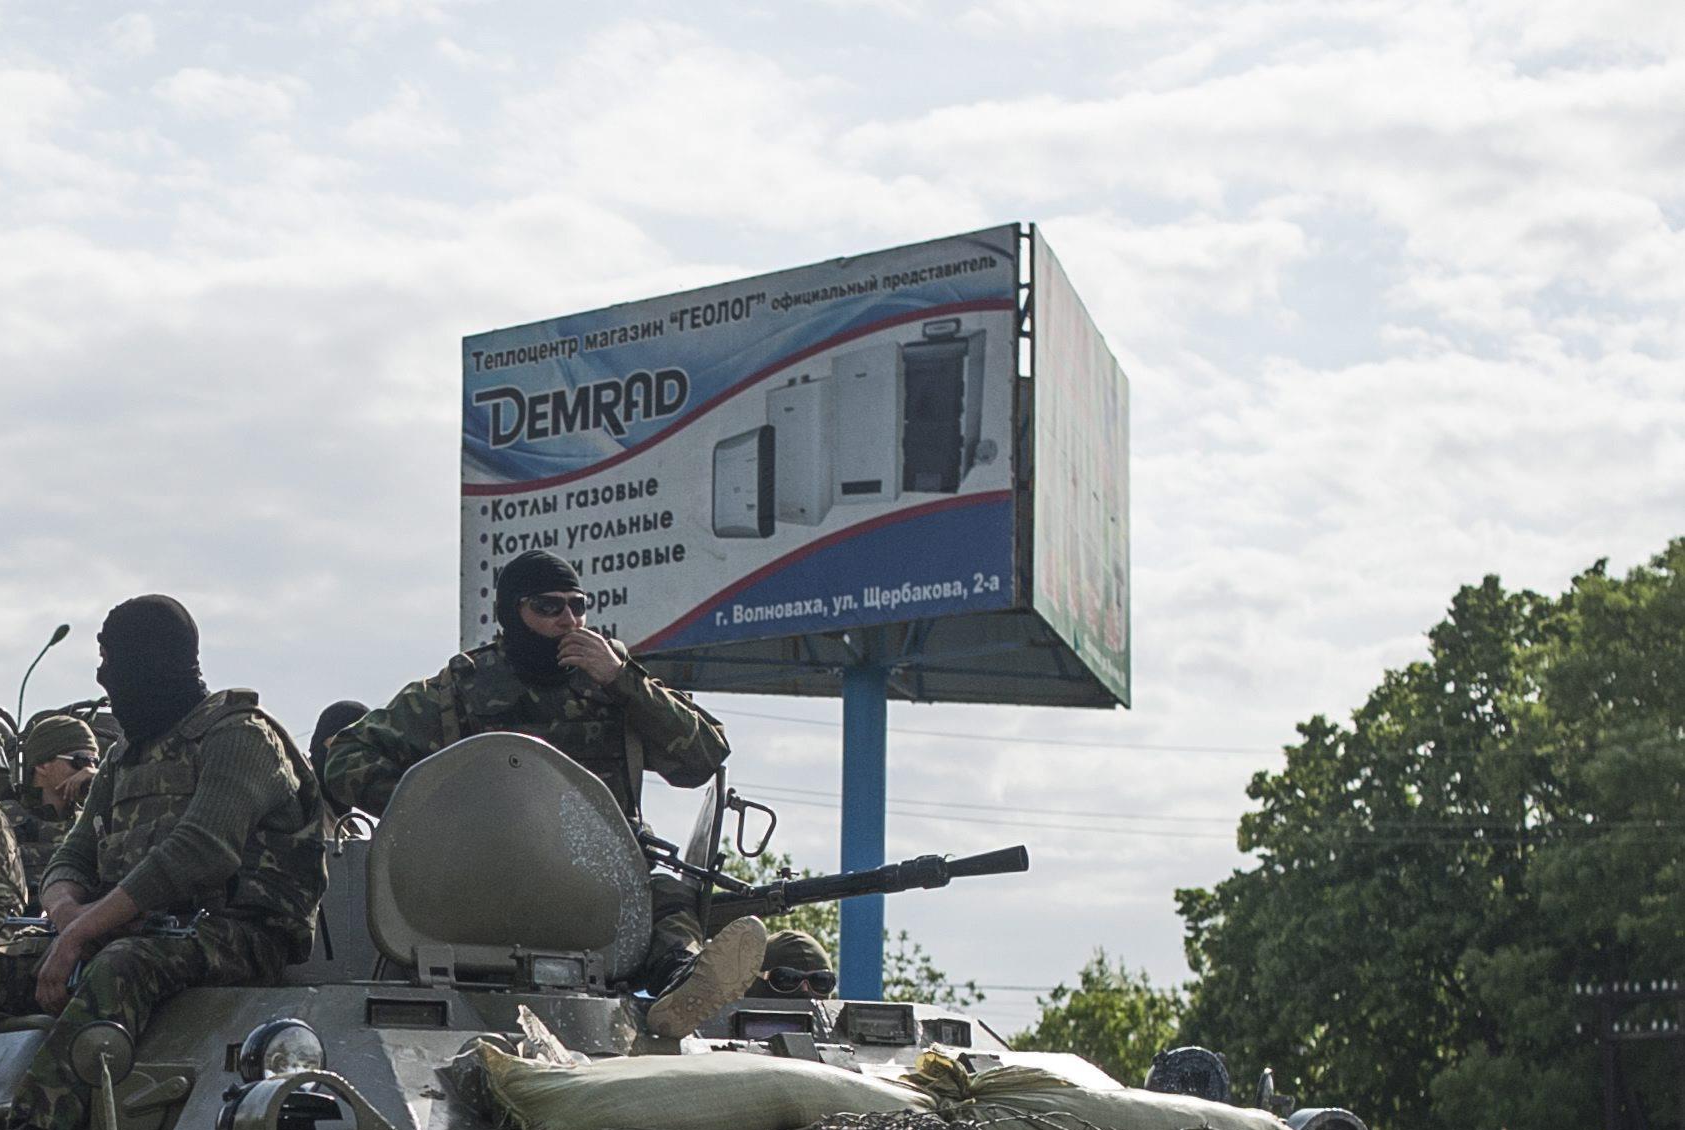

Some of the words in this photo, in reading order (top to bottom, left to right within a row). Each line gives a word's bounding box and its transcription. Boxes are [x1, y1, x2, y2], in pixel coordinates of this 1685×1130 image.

[471, 336, 578, 372] Теплоцентр
[584, 318, 664, 351] магазин
[771, 275, 878, 311] официальный
[882, 255, 998, 291] представитель
[474, 368, 689, 448] DEMRAD
[491, 495, 557, 523] Котлы
[566, 477, 659, 510] газовые
[492, 528, 558, 556] Котлы
[567, 509, 674, 550] угольные
[591, 543, 686, 575] газовые
[715, 610, 728, 626] г.
[733, 598, 828, 625] Волноваха,
[832, 594, 858, 617] ул.
[863, 578, 967, 611] Щербакова,
[973, 572, 1000, 594] 2-а
